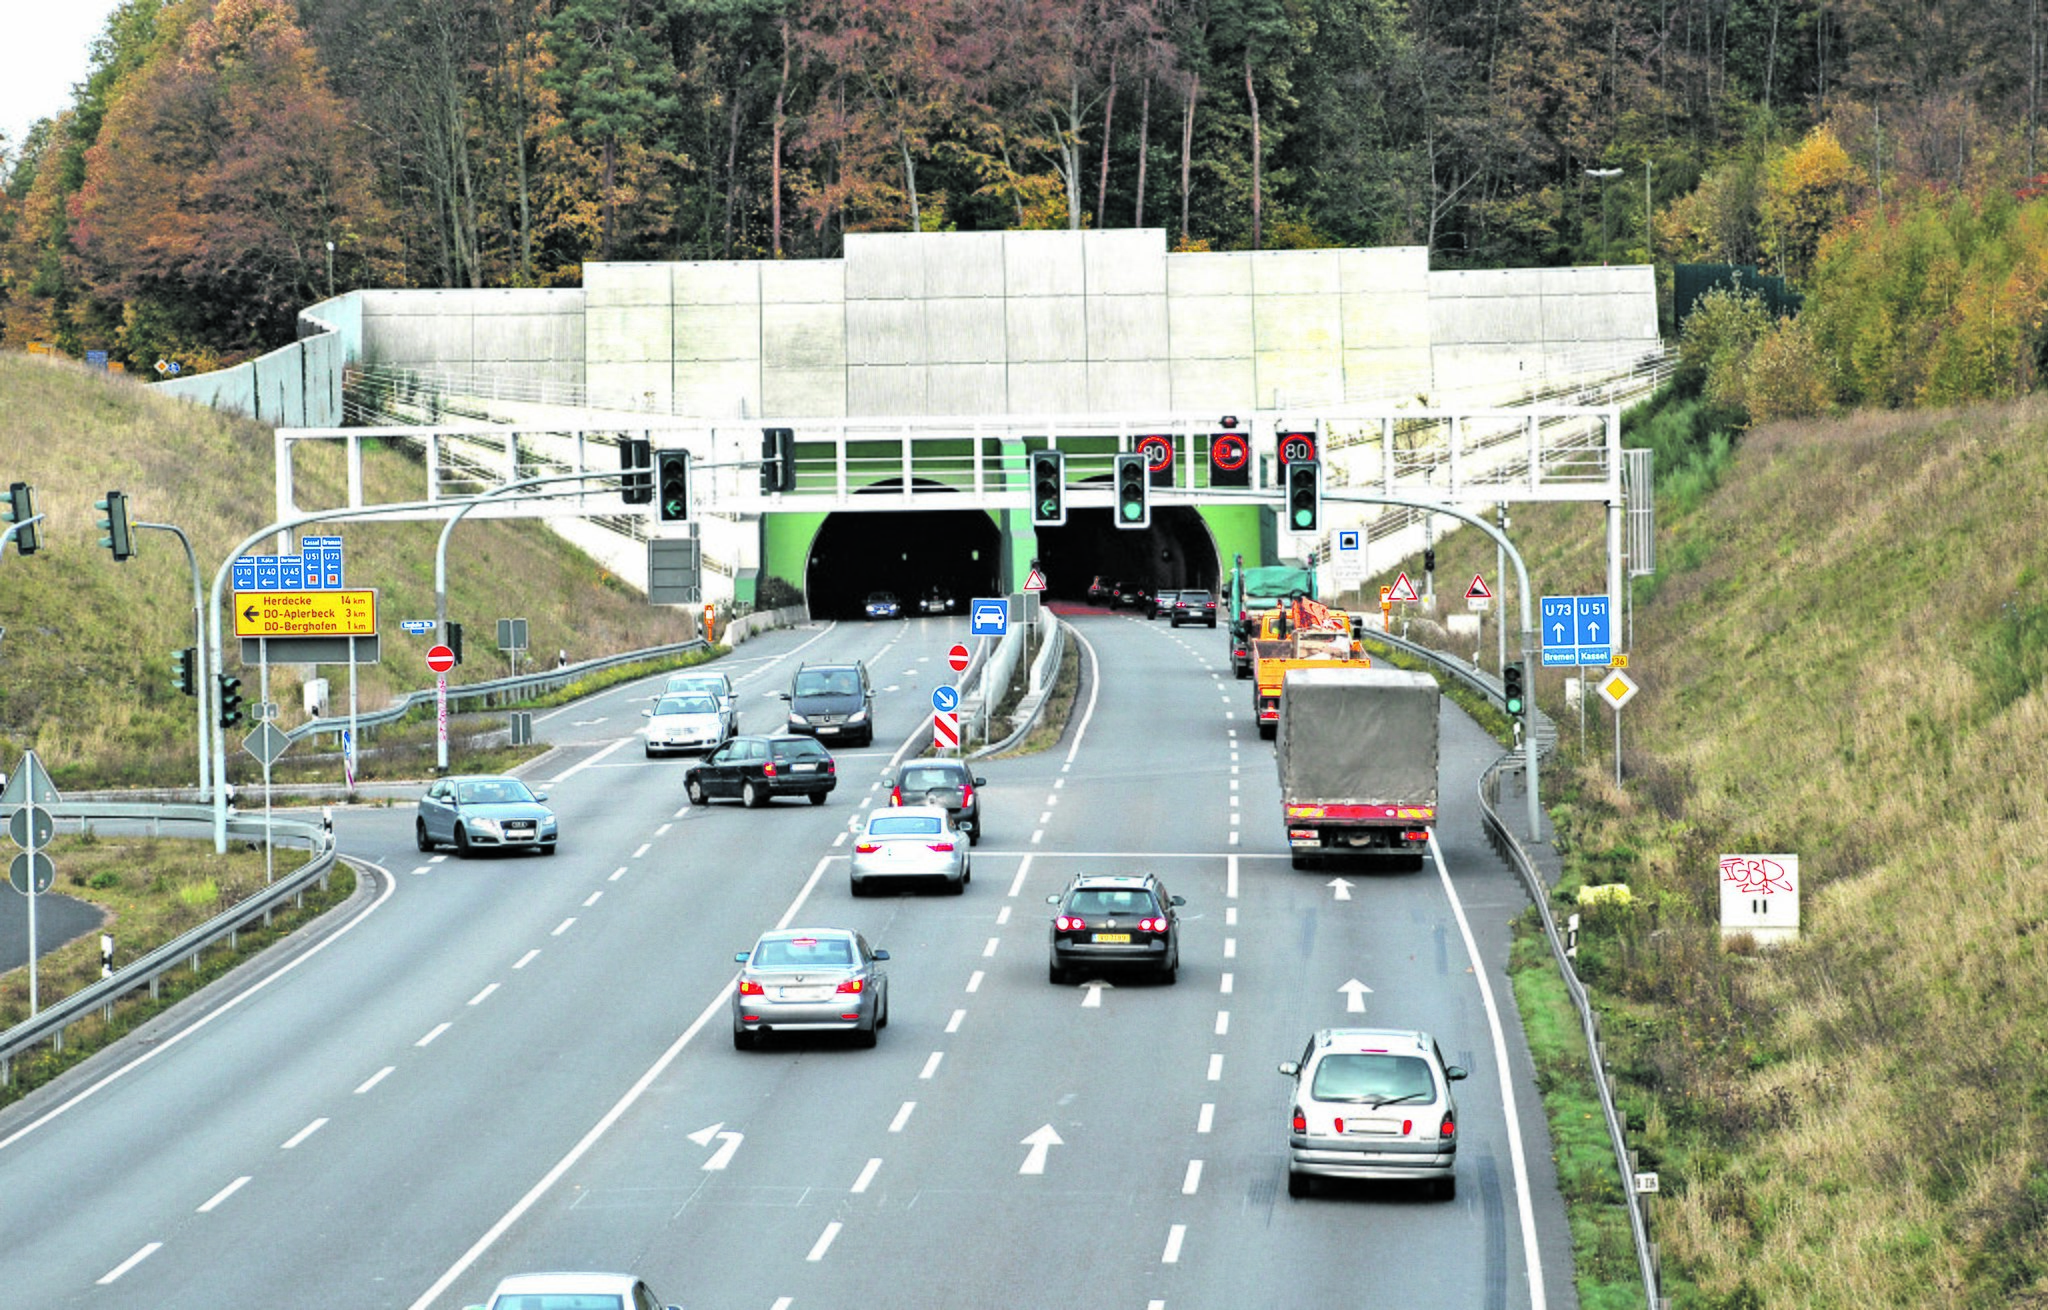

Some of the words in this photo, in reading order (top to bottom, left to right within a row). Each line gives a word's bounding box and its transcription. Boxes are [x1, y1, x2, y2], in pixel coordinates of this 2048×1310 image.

[1144, 446, 1166, 462] 80
[1286, 444, 1307, 460] 80
[331, 552, 340, 560] 73
[236, 568, 242, 576] U
[244, 568, 252, 576] 10
[290, 567, 299, 575] 45
[264, 596, 312, 606] Herdecke
[341, 596, 351, 605] 14
[353, 597, 365, 605] km
[264, 608, 335, 620] DO-Aplerbeck
[346, 609, 352, 618] 3
[1545, 604, 1555, 616] U
[1557, 604, 1572, 616] 73
[1580, 604, 1590, 615] U
[1592, 603, 1606, 615] 51
[264, 621, 337, 632] DO-Berghofen
[354, 622, 366, 630] km
[1544, 653, 1574, 661] Bremen
[1581, 652, 1608, 661] Kassel
